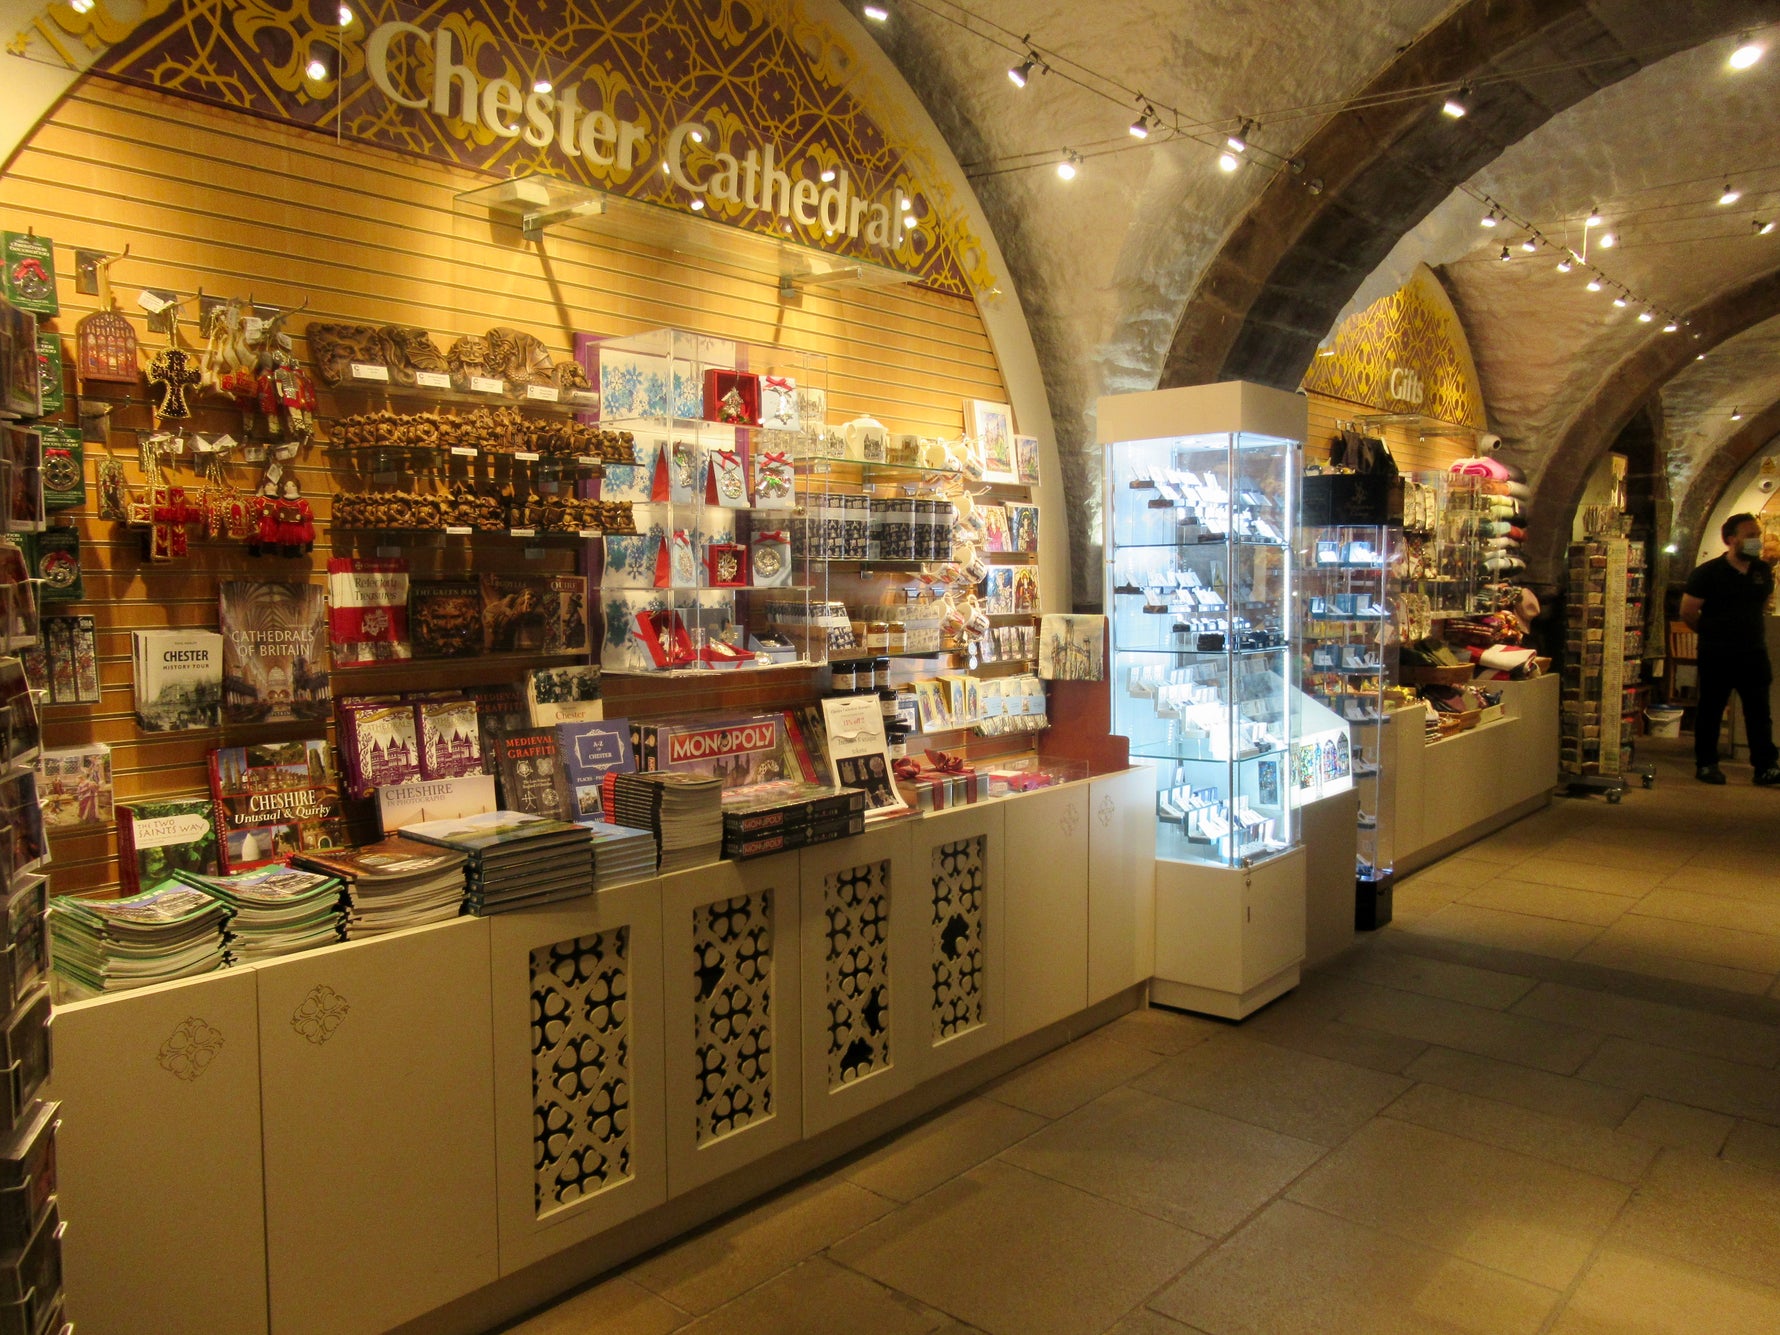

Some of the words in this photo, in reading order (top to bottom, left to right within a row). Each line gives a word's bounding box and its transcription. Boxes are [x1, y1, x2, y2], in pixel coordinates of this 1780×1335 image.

[367, 20, 645, 171] Chester
[667, 121, 905, 251] Cathedral
[1391, 367, 1424, 403] Gifts
[231, 630, 315, 643] CATHEDRALS
[163, 650, 209, 662] CHESTER
[238, 645, 256, 657] OF
[259, 643, 311, 656] BRITAIN
[555, 711, 587, 720] Chester
[505, 735, 555, 748] MEDIEVAL
[672, 726, 774, 759] MONOPOLY
[507, 745, 557, 759] GRAFFITI
[588, 752, 613, 760] CHESTER
[385, 783, 454, 801] CHESHIRE
[250, 789, 317, 813] CHESHIRE
[234, 809, 281, 825] Unusual
[283, 808, 295, 819] &
[296, 804, 332, 819] Quirky
[744, 814, 783, 831] MONOPOLY
[138, 825, 177, 838] SAINTS
[179, 822, 206, 833] WAY
[153, 818, 176, 828] TWO
[744, 838, 783, 856] MONOPOLY
